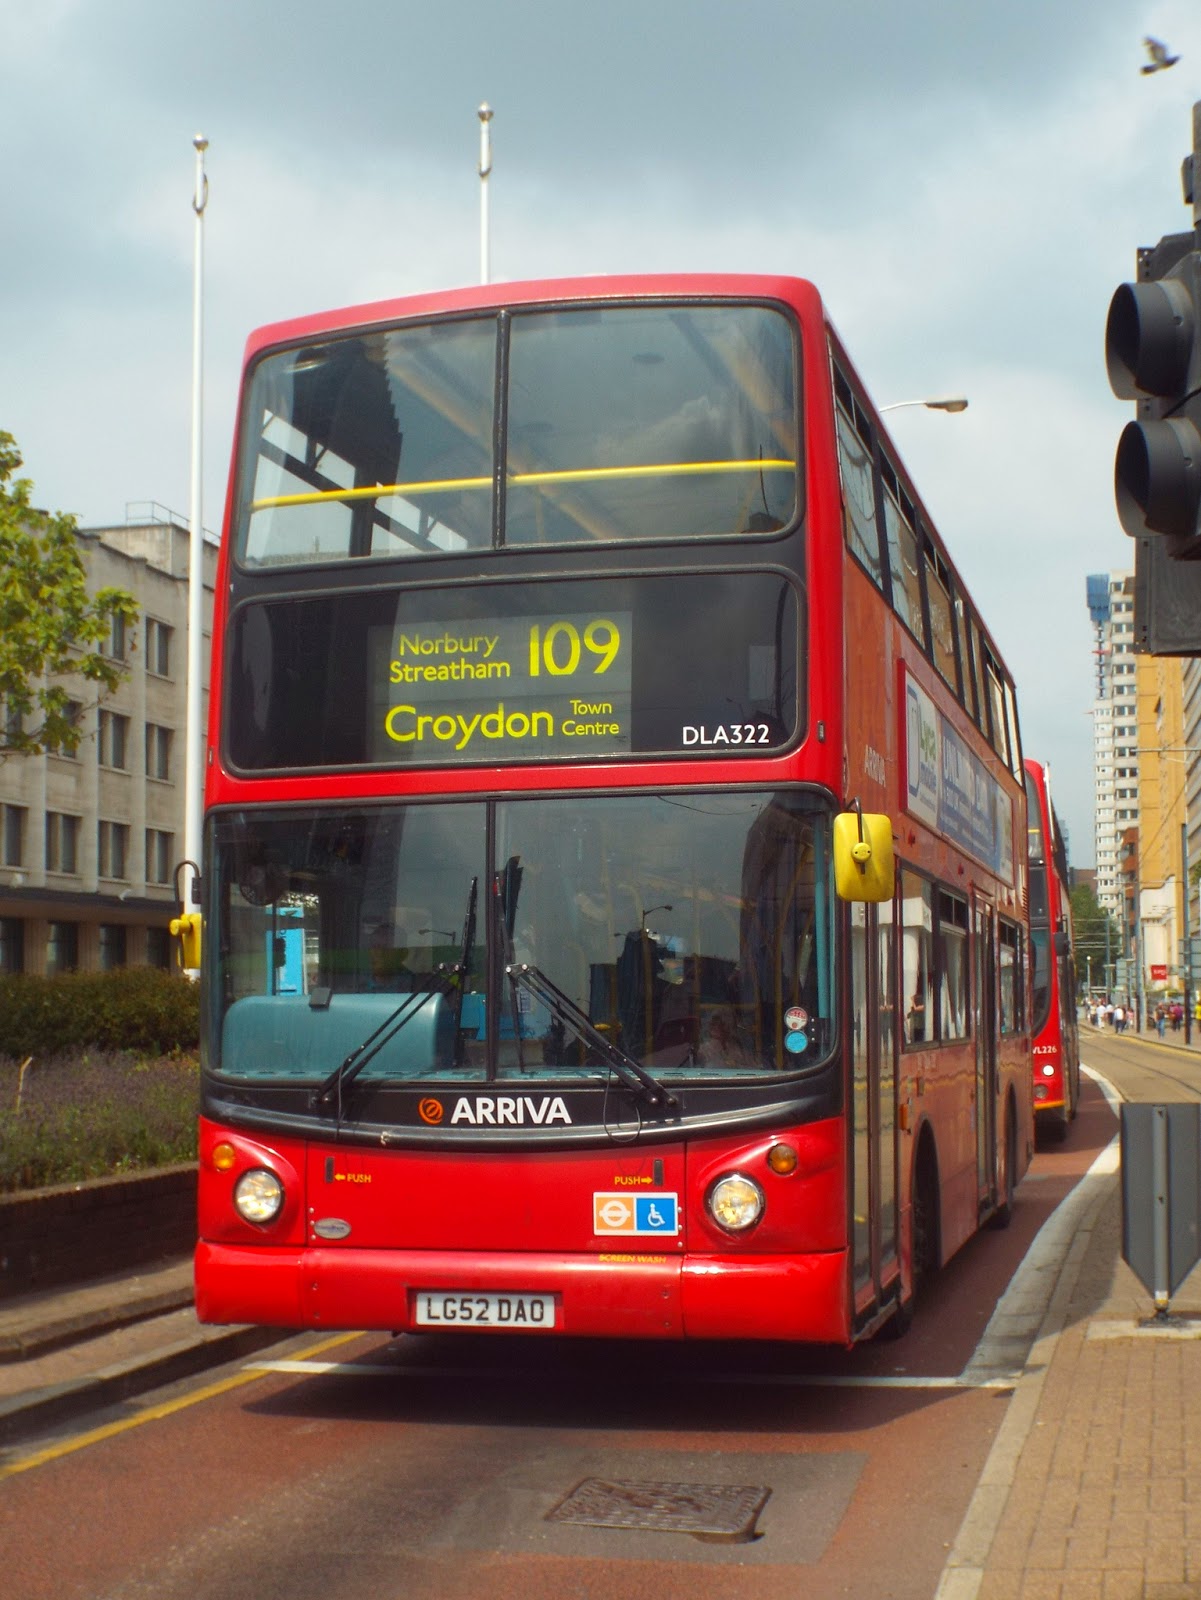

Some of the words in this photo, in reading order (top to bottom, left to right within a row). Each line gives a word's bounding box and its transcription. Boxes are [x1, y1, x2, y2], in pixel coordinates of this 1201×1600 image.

[400, 632, 499, 657] Norbury
[529, 618, 620, 677] 109
[389, 658, 510, 683] Streatham
[569, 699, 613, 715] Town
[384, 702, 554, 750] Croydon
[562, 720, 620, 737] Centre
[682, 723, 770, 745] DLA322
[450, 1097, 573, 1124] ARRIVA
[347, 1173, 372, 1184] PUSH
[614, 1176, 641, 1185] PUSH
[598, 1254, 635, 1263] SCREEN
[637, 1255, 667, 1264] WASH
[426, 1297, 490, 1322] LG52
[497, 1299, 545, 1323] DAO
